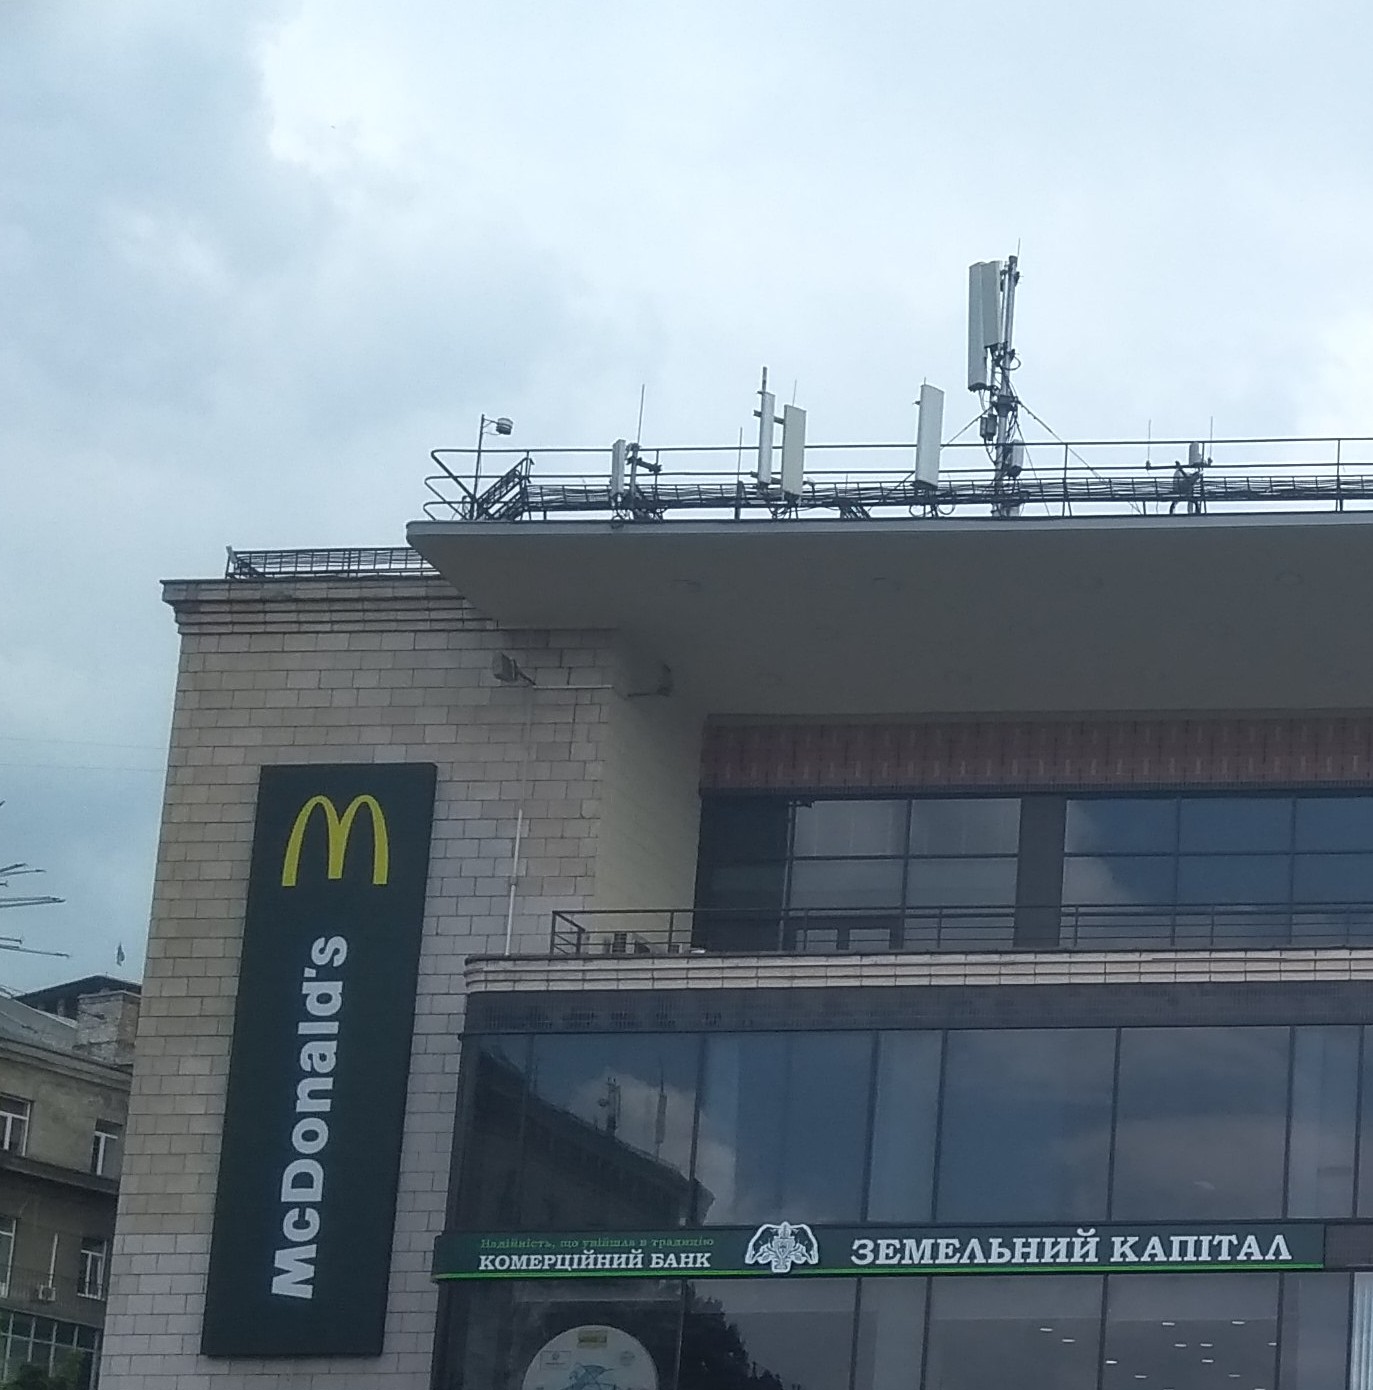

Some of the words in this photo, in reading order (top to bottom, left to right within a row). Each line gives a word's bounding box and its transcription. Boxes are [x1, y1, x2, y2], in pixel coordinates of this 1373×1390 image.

[271, 934, 348, 1300] McDonald's
[478, 1249, 644, 1271] КОМЕРЦІЙНИЙ
[648, 1253, 712, 1269] БАНК
[851, 1228, 1099, 1265] ЗЕМЕЛЬНИЙ
[1110, 1234, 1293, 1262] КАПІТАЛ
